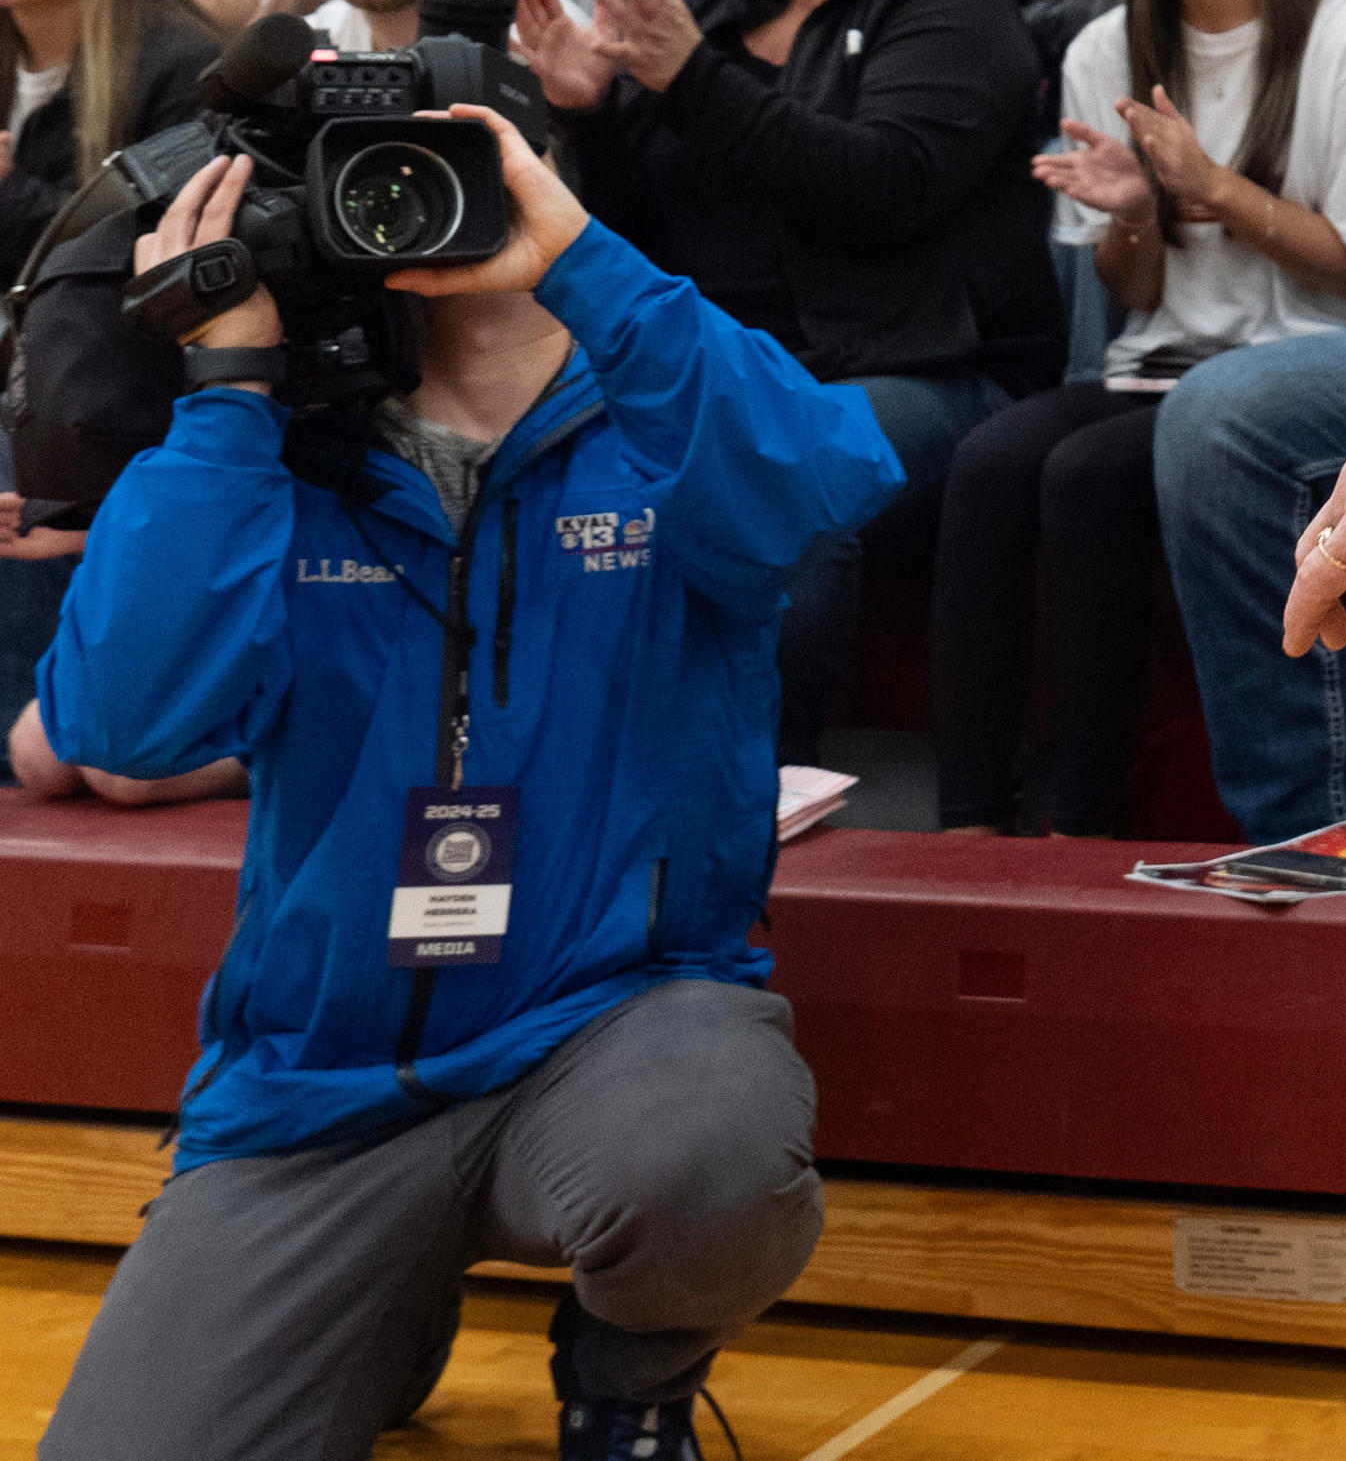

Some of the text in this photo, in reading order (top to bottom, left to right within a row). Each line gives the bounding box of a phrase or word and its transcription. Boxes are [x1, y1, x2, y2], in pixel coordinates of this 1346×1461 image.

[579, 525, 617, 550] 13
[583, 548, 651, 573] NEWS
[424, 803, 501, 820] 2024-25
[415, 941, 476, 956] MEDIA
